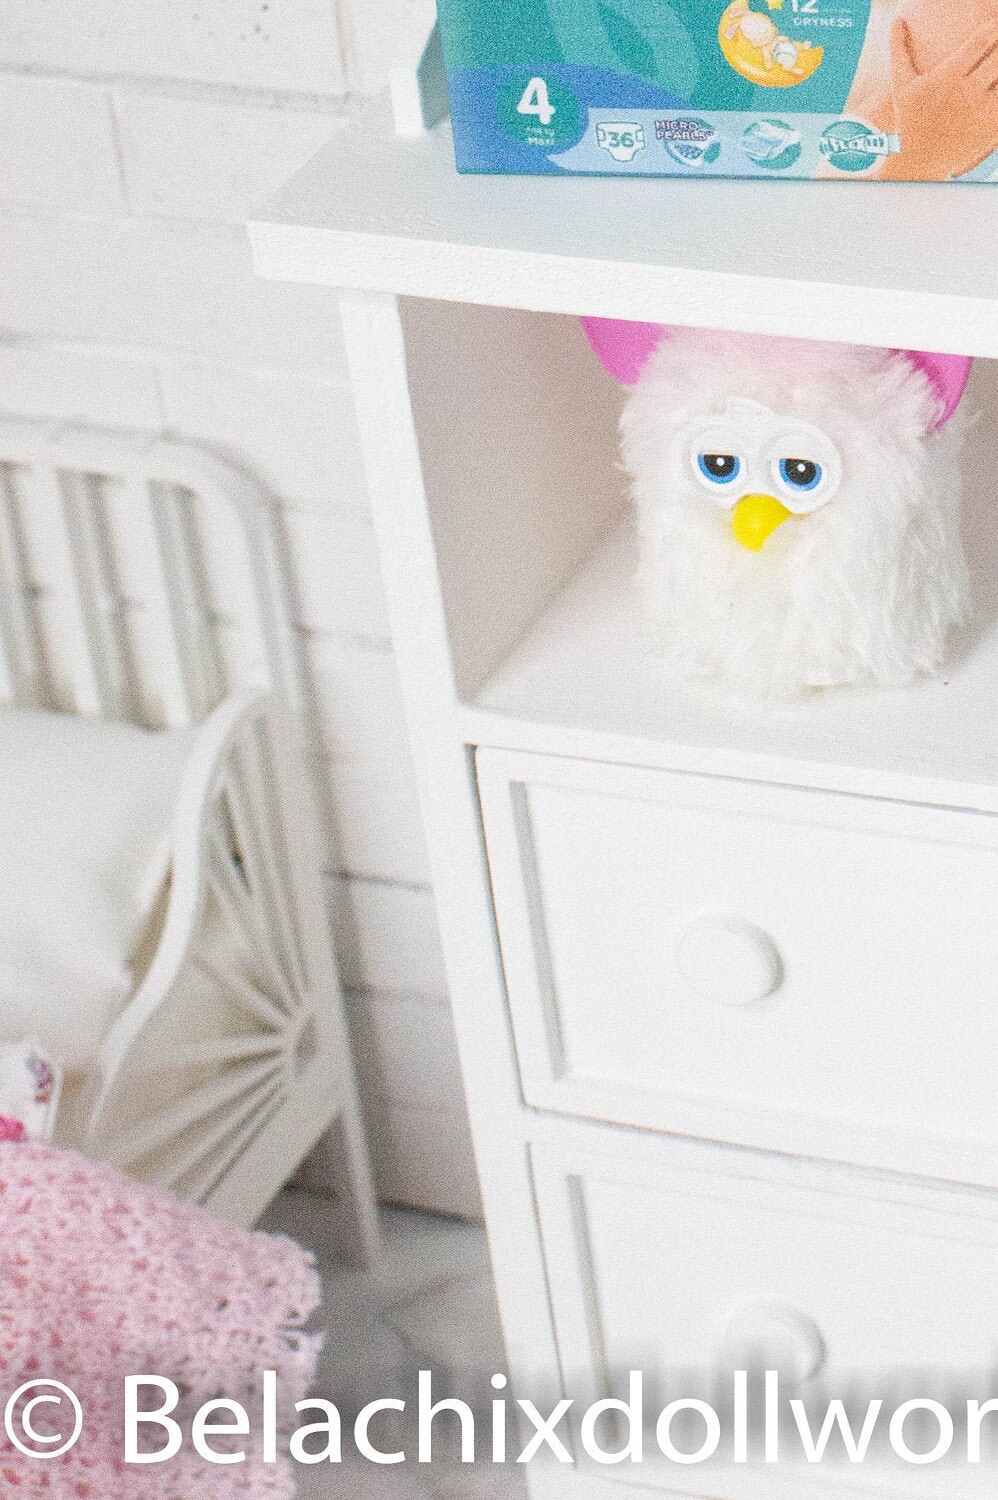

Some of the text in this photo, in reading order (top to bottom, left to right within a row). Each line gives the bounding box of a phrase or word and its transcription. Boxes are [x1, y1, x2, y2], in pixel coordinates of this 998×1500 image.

[516, 76, 556, 125] 4
[655, 120, 699, 131] MICRO
[607, 131, 635, 148] 36
